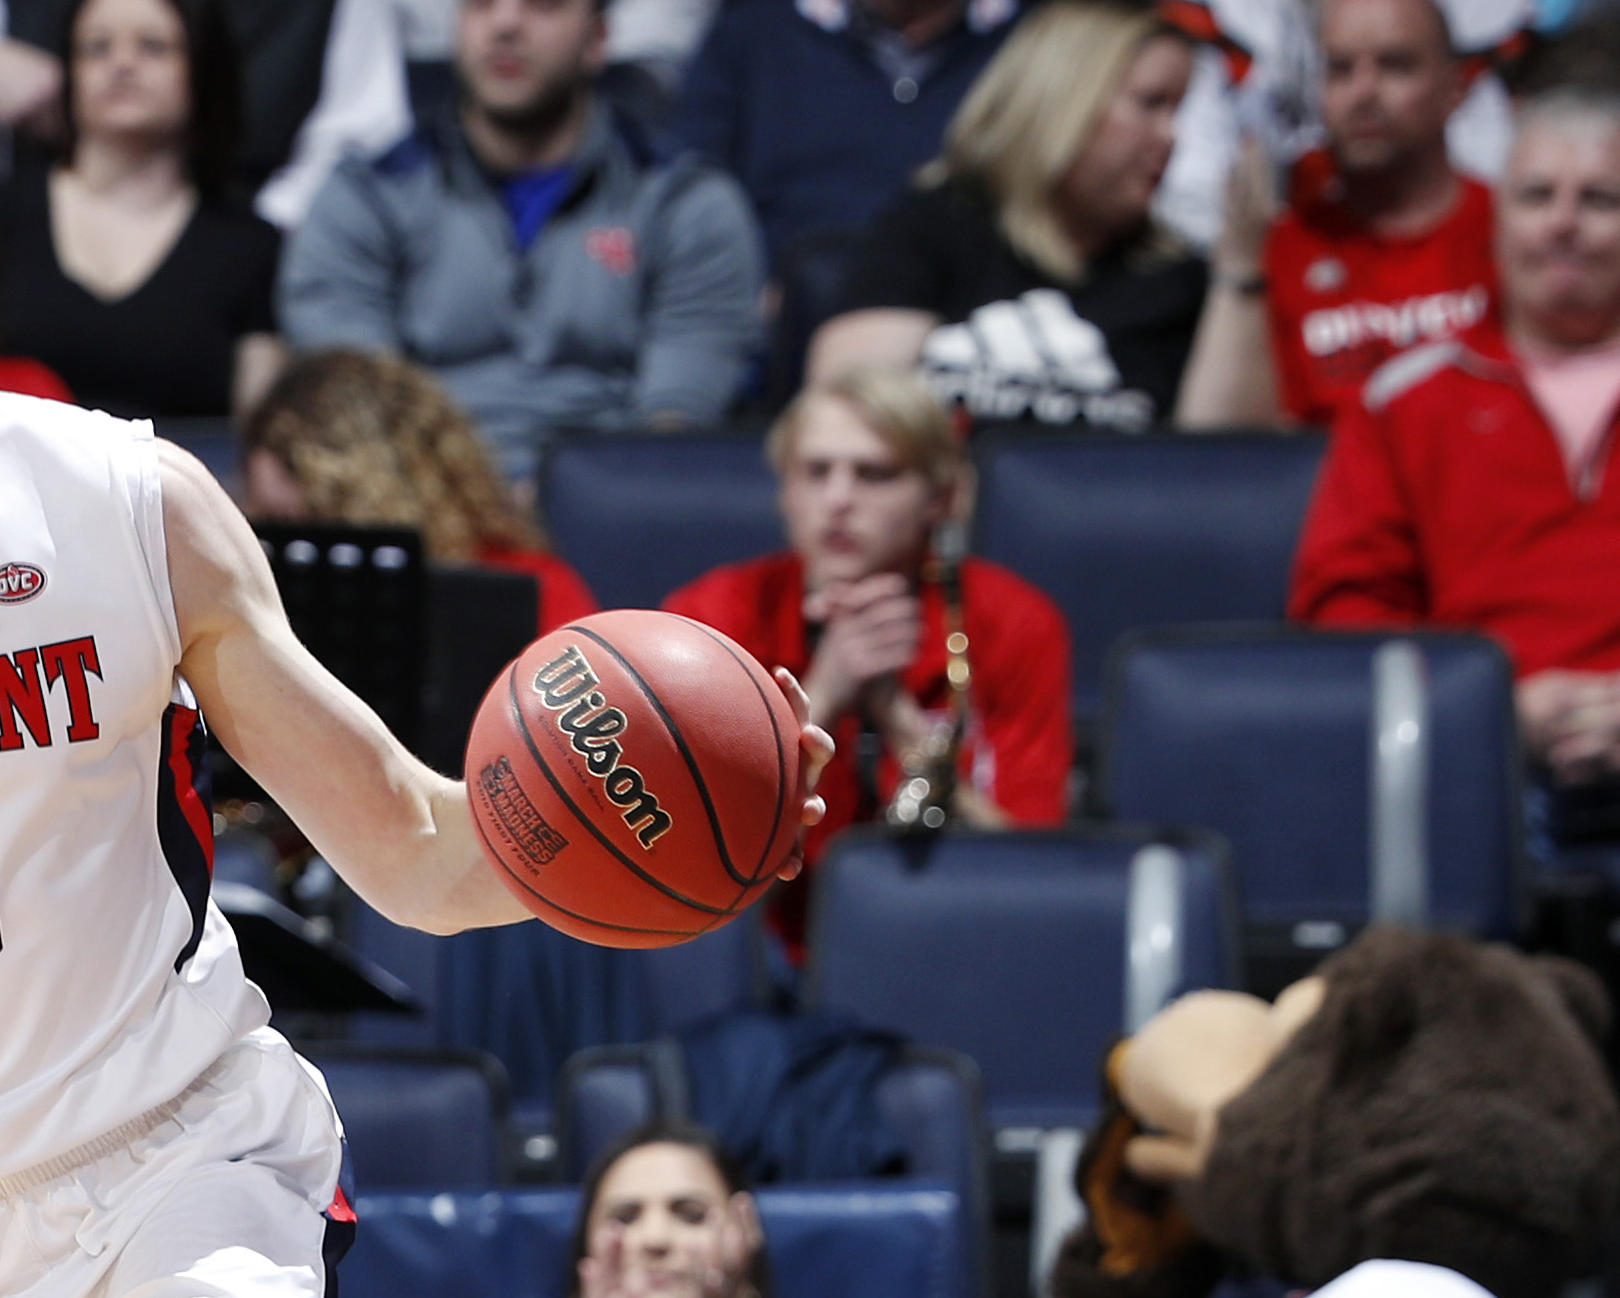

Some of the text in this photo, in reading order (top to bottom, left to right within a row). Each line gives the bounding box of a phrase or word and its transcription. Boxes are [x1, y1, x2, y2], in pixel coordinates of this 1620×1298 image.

[532, 644, 674, 850] Wilson
[495, 790, 553, 863] MADNESS
[498, 771, 543, 831] MARCH
